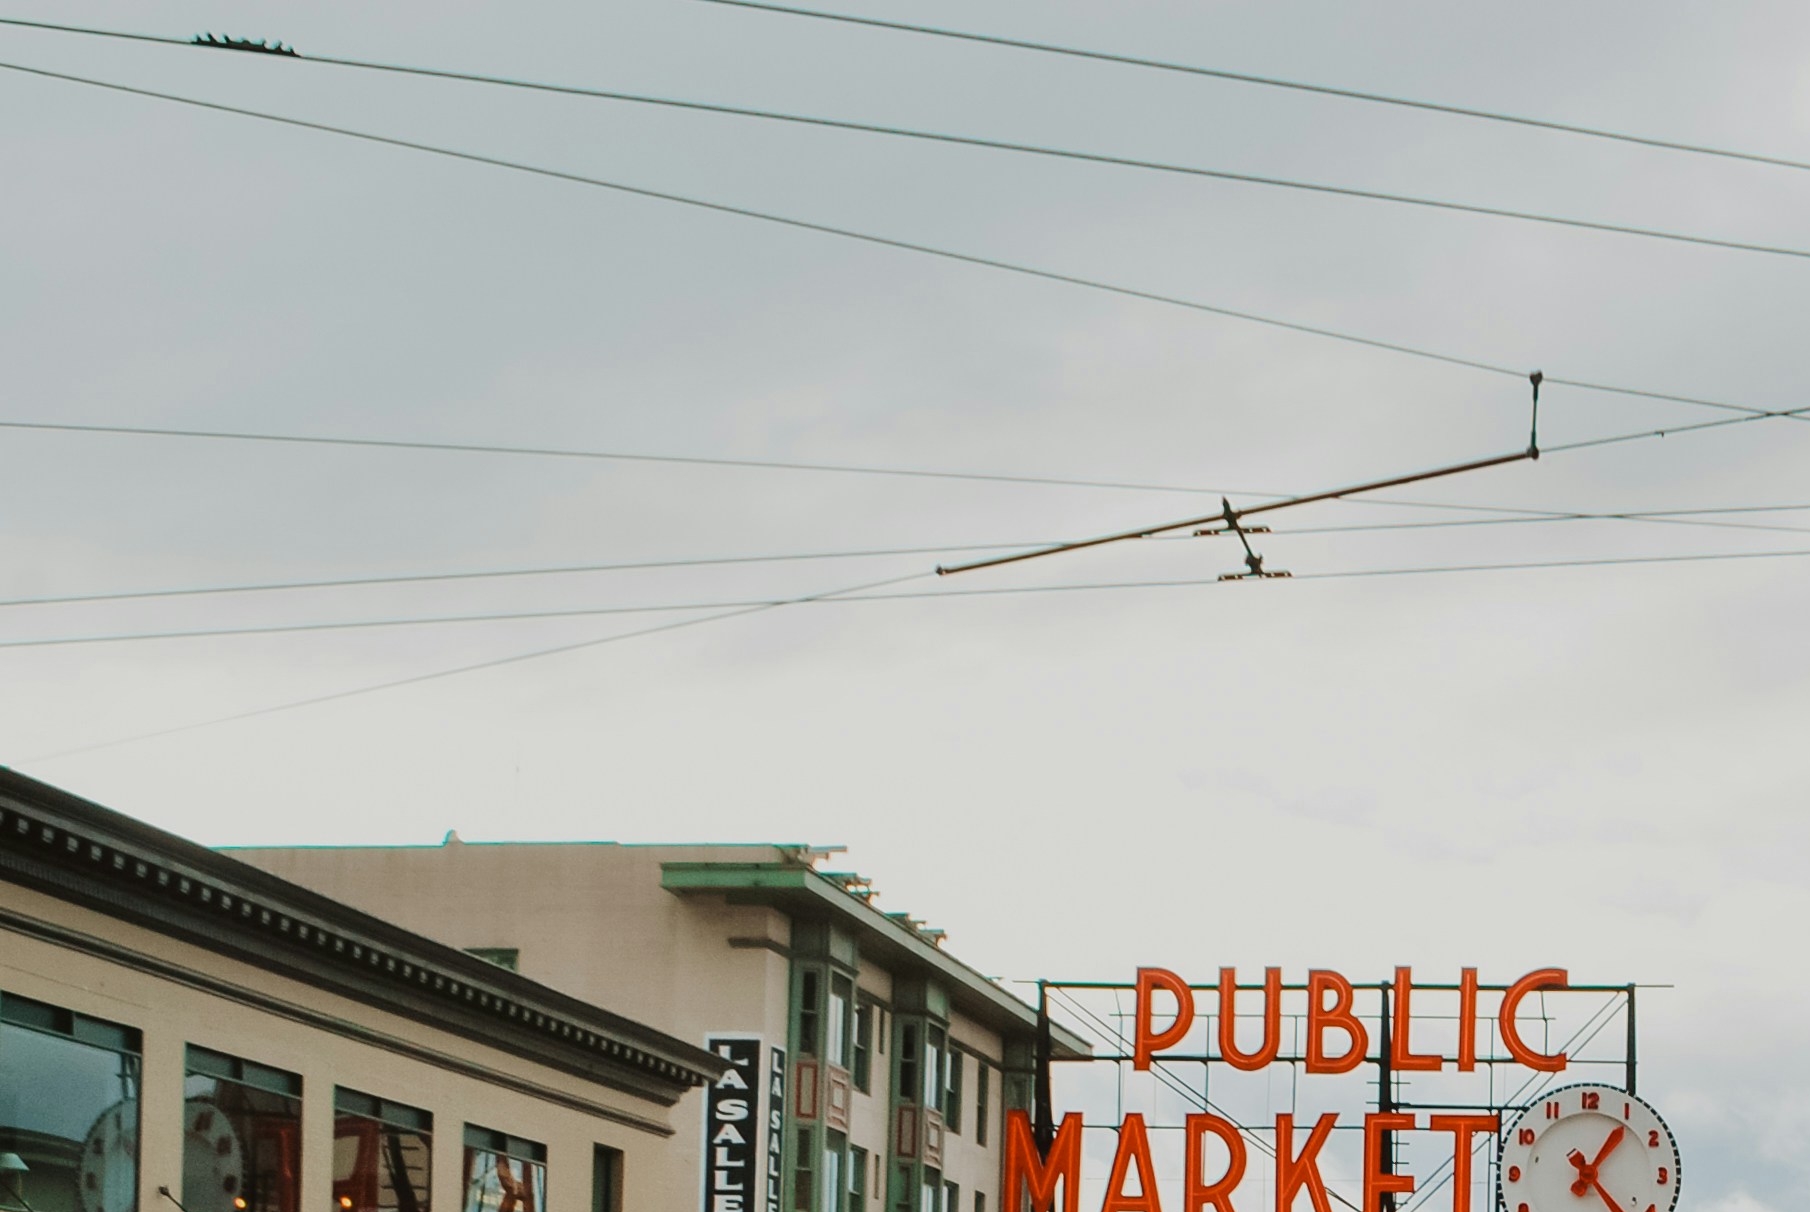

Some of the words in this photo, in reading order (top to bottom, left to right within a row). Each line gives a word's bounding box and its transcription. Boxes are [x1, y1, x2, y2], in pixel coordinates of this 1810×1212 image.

[1133, 965, 1569, 1075] PUBLIC
[714, 1044, 749, 1089] LA
[770, 1051, 783, 1098] LA
[1581, 1091, 1600, 1110] 12
[1546, 1101, 1560, 1120] 11
[1624, 1102, 1630, 1120] 1
[1518, 1128, 1536, 1146] 10
[1648, 1130, 1659, 1148] 2
[1508, 1165, 1521, 1183] 9
[1656, 1167, 1668, 1185] 3
